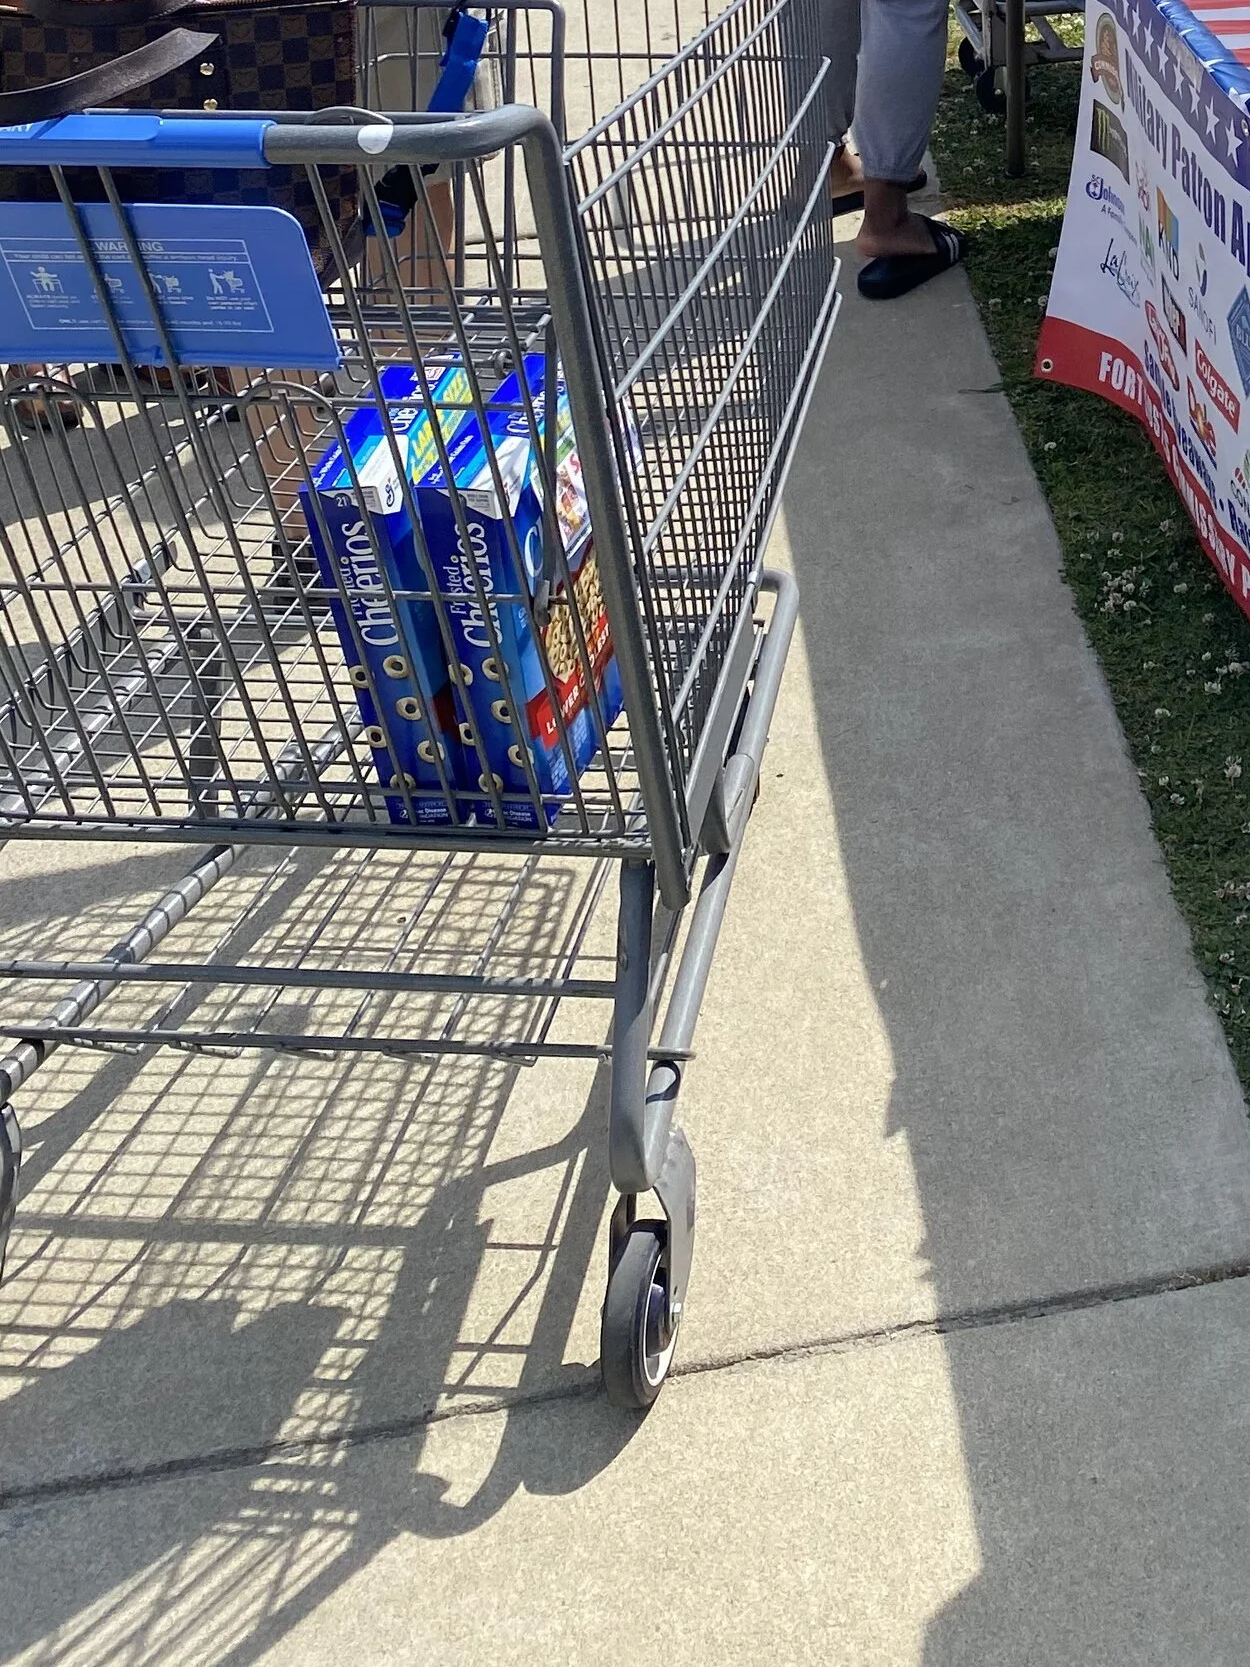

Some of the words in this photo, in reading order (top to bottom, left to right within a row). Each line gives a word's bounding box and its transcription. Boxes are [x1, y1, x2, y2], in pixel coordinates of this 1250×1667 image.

[1124, 47, 1168, 170] Military
[1171, 122, 1227, 245] Patron
[95, 241, 164, 252] WARING
[1099, 351, 1143, 406] FORT
[1196, 349, 1236, 419] Colgate
[336, 496, 348, 508] 21
[341, 520, 400, 647] Cheerios
[443, 566, 467, 615] Frsted
[454, 522, 503, 648] Cheerios
